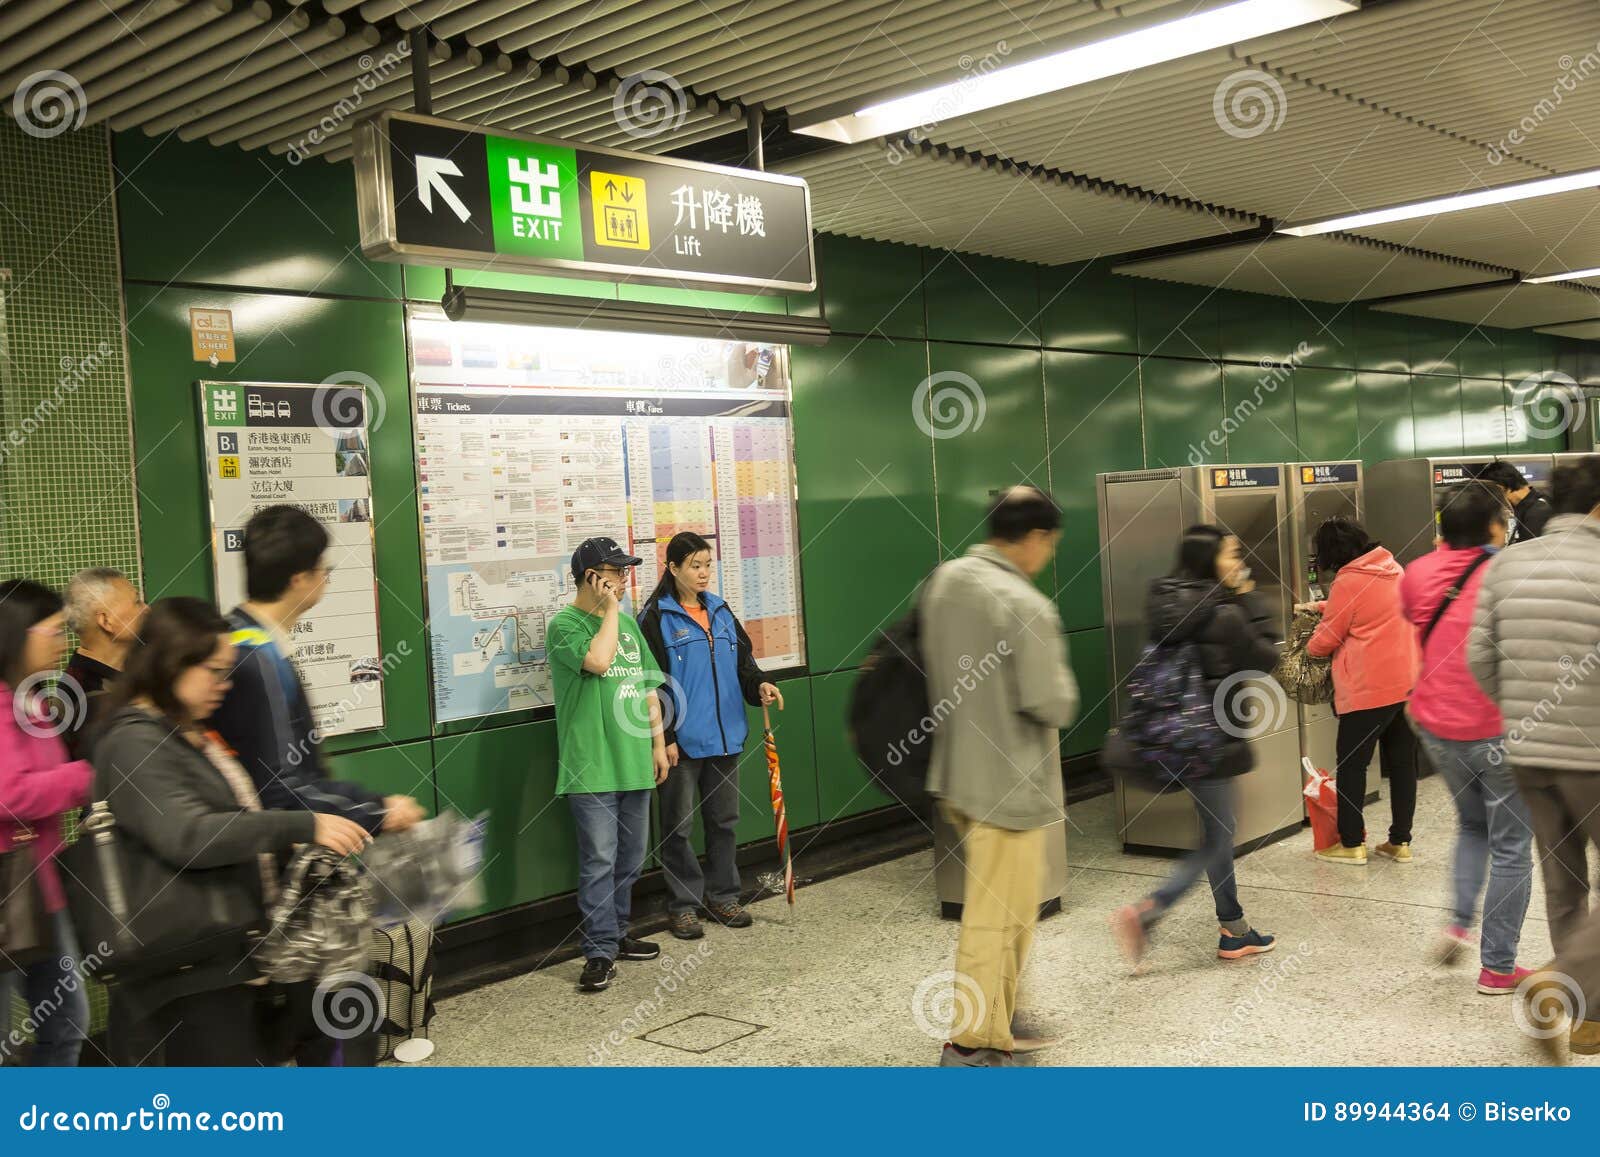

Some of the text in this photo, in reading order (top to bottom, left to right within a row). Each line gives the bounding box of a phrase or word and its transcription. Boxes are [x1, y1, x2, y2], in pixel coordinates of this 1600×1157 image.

[507, 158, 562, 219] 出
[671, 184, 767, 238] 升降機
[512, 216, 563, 241] EXIT
[675, 234, 702, 257] Lift
[418, 397, 442, 411] 車票
[446, 402, 471, 412] Tickets
[214, 412, 237, 421] EXIT
[220, 435, 235, 451] B1
[227, 533, 242, 549] B2
